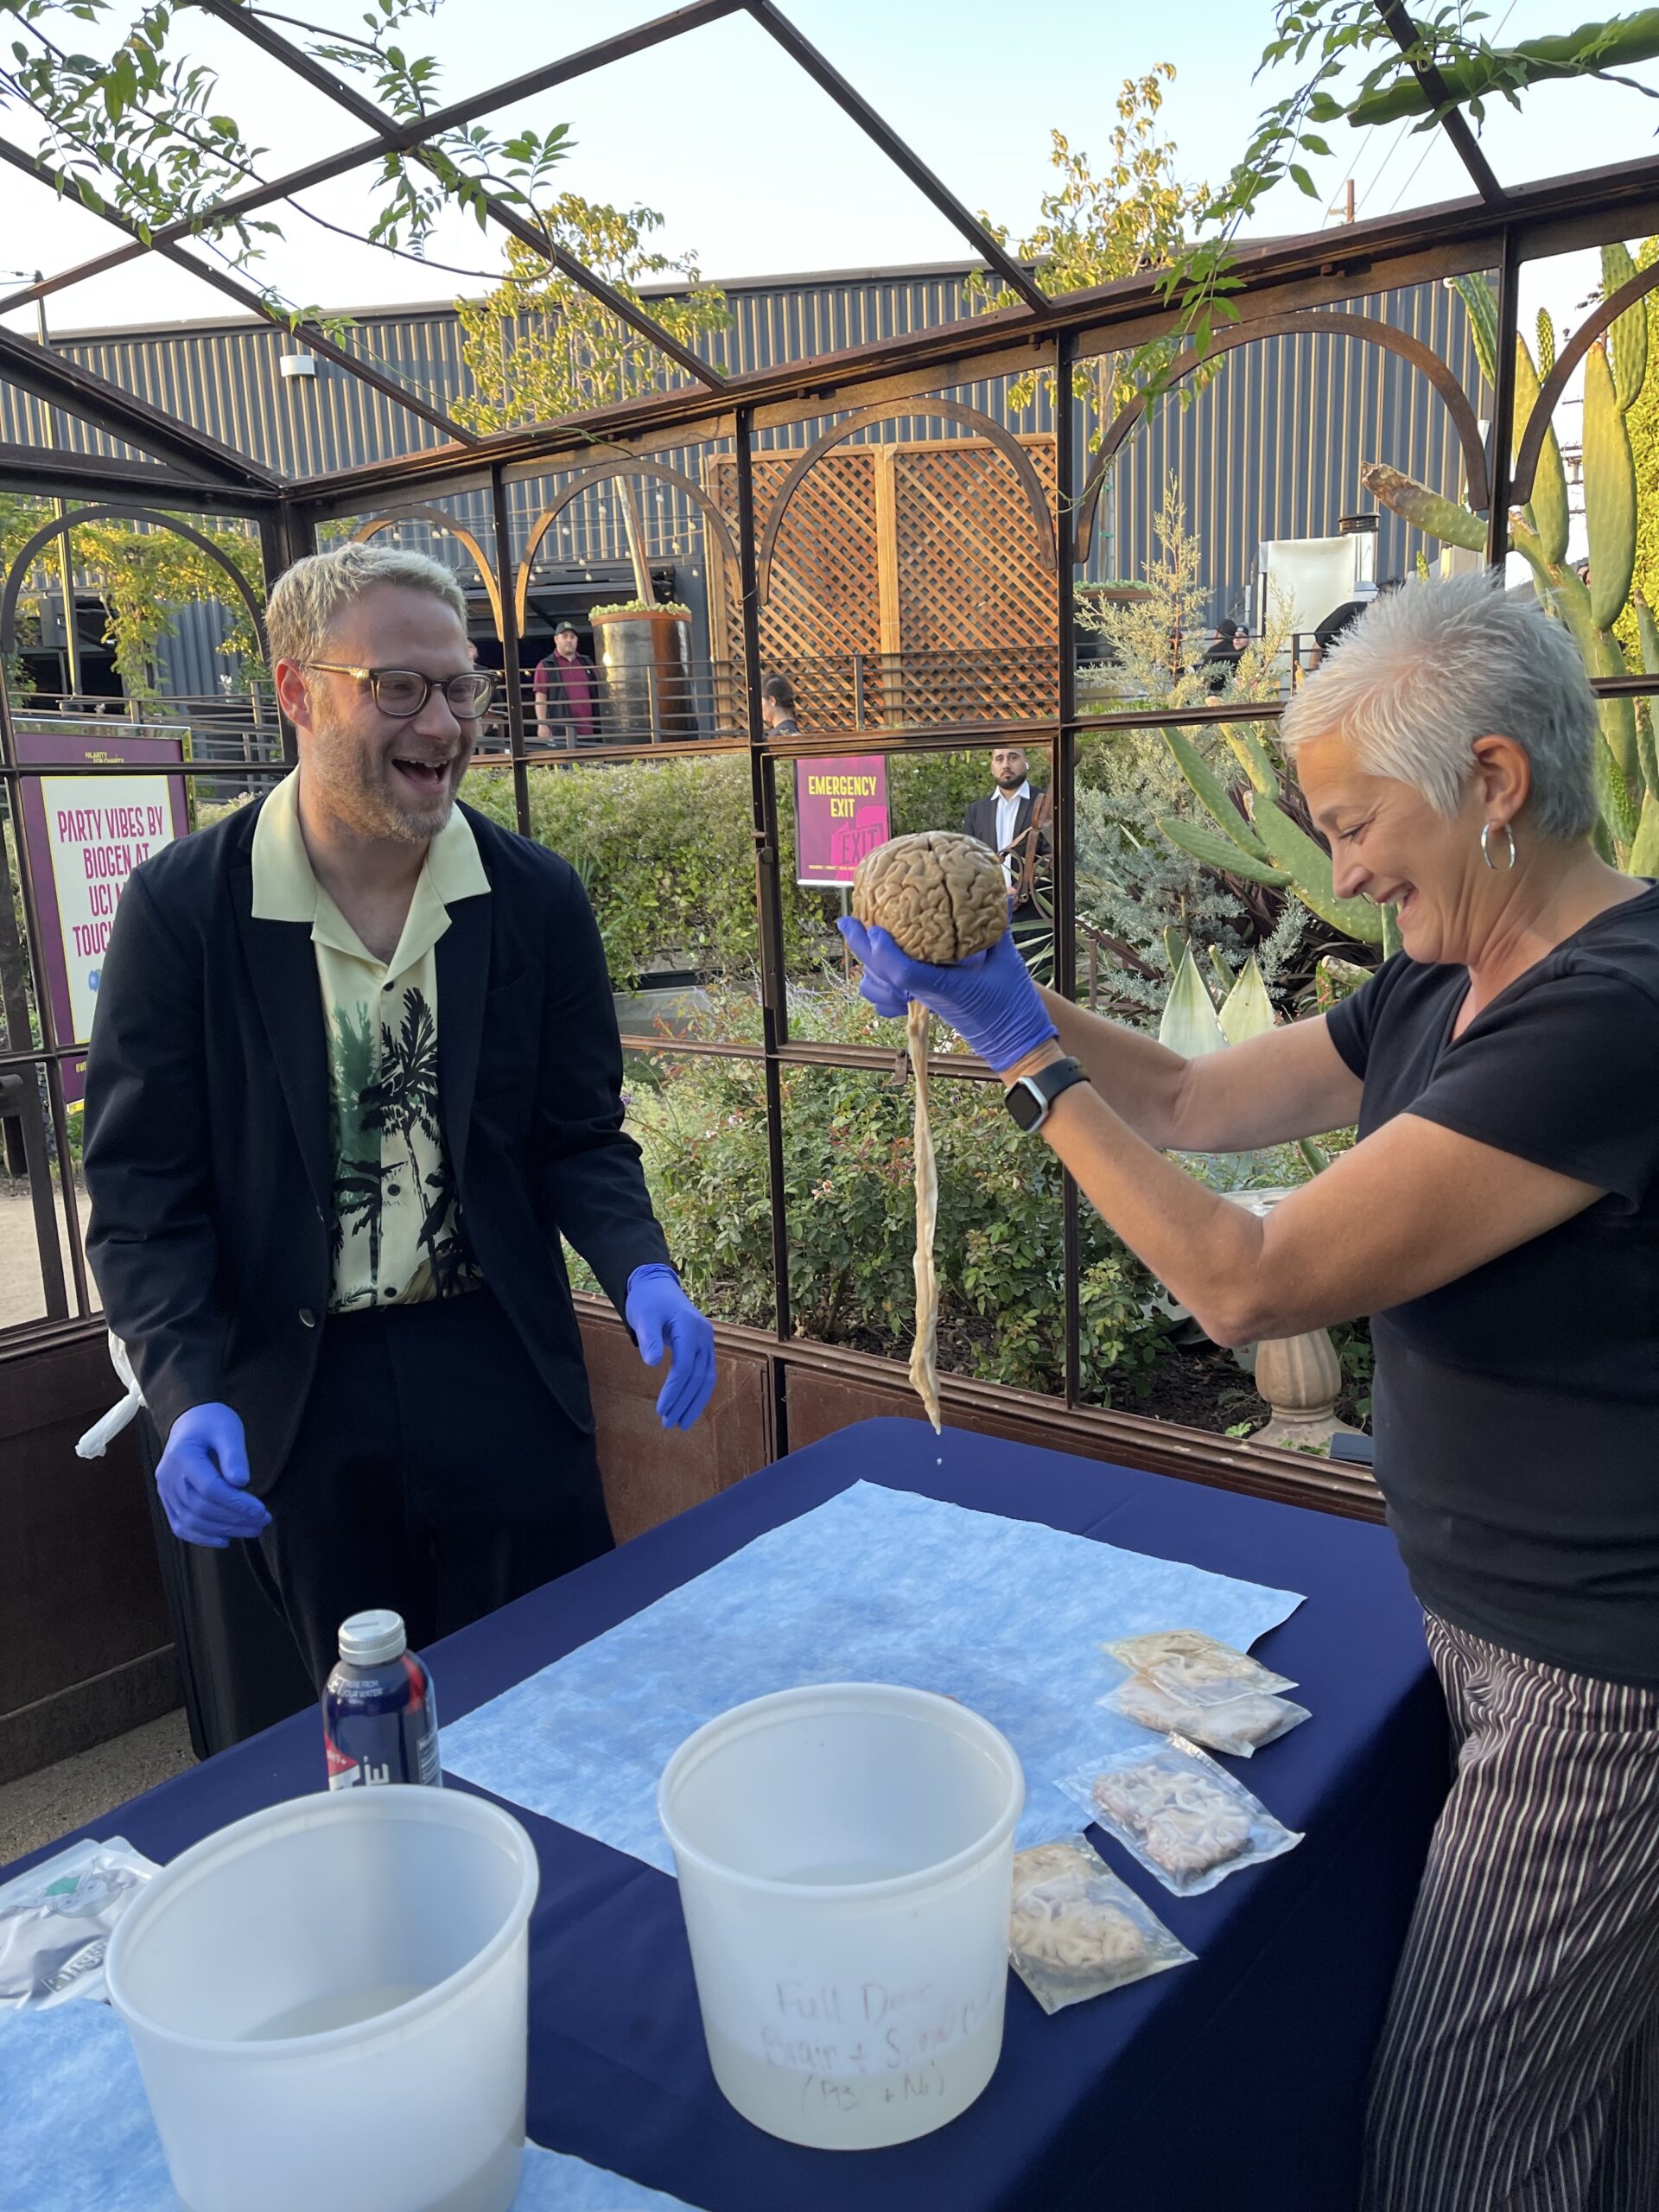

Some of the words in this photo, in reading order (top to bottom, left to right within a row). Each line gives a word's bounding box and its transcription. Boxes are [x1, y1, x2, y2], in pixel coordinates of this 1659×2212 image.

[808, 776, 877, 796] EMERGENCY
[57, 809, 101, 842] PARTY
[105, 806, 144, 839] VIBES
[147, 805, 163, 836] BY
[830, 798, 855, 817] EXIT
[82, 844, 131, 880] BIOGEN
[89, 883, 113, 917] UCI
[774, 1979, 842, 2025] Full
